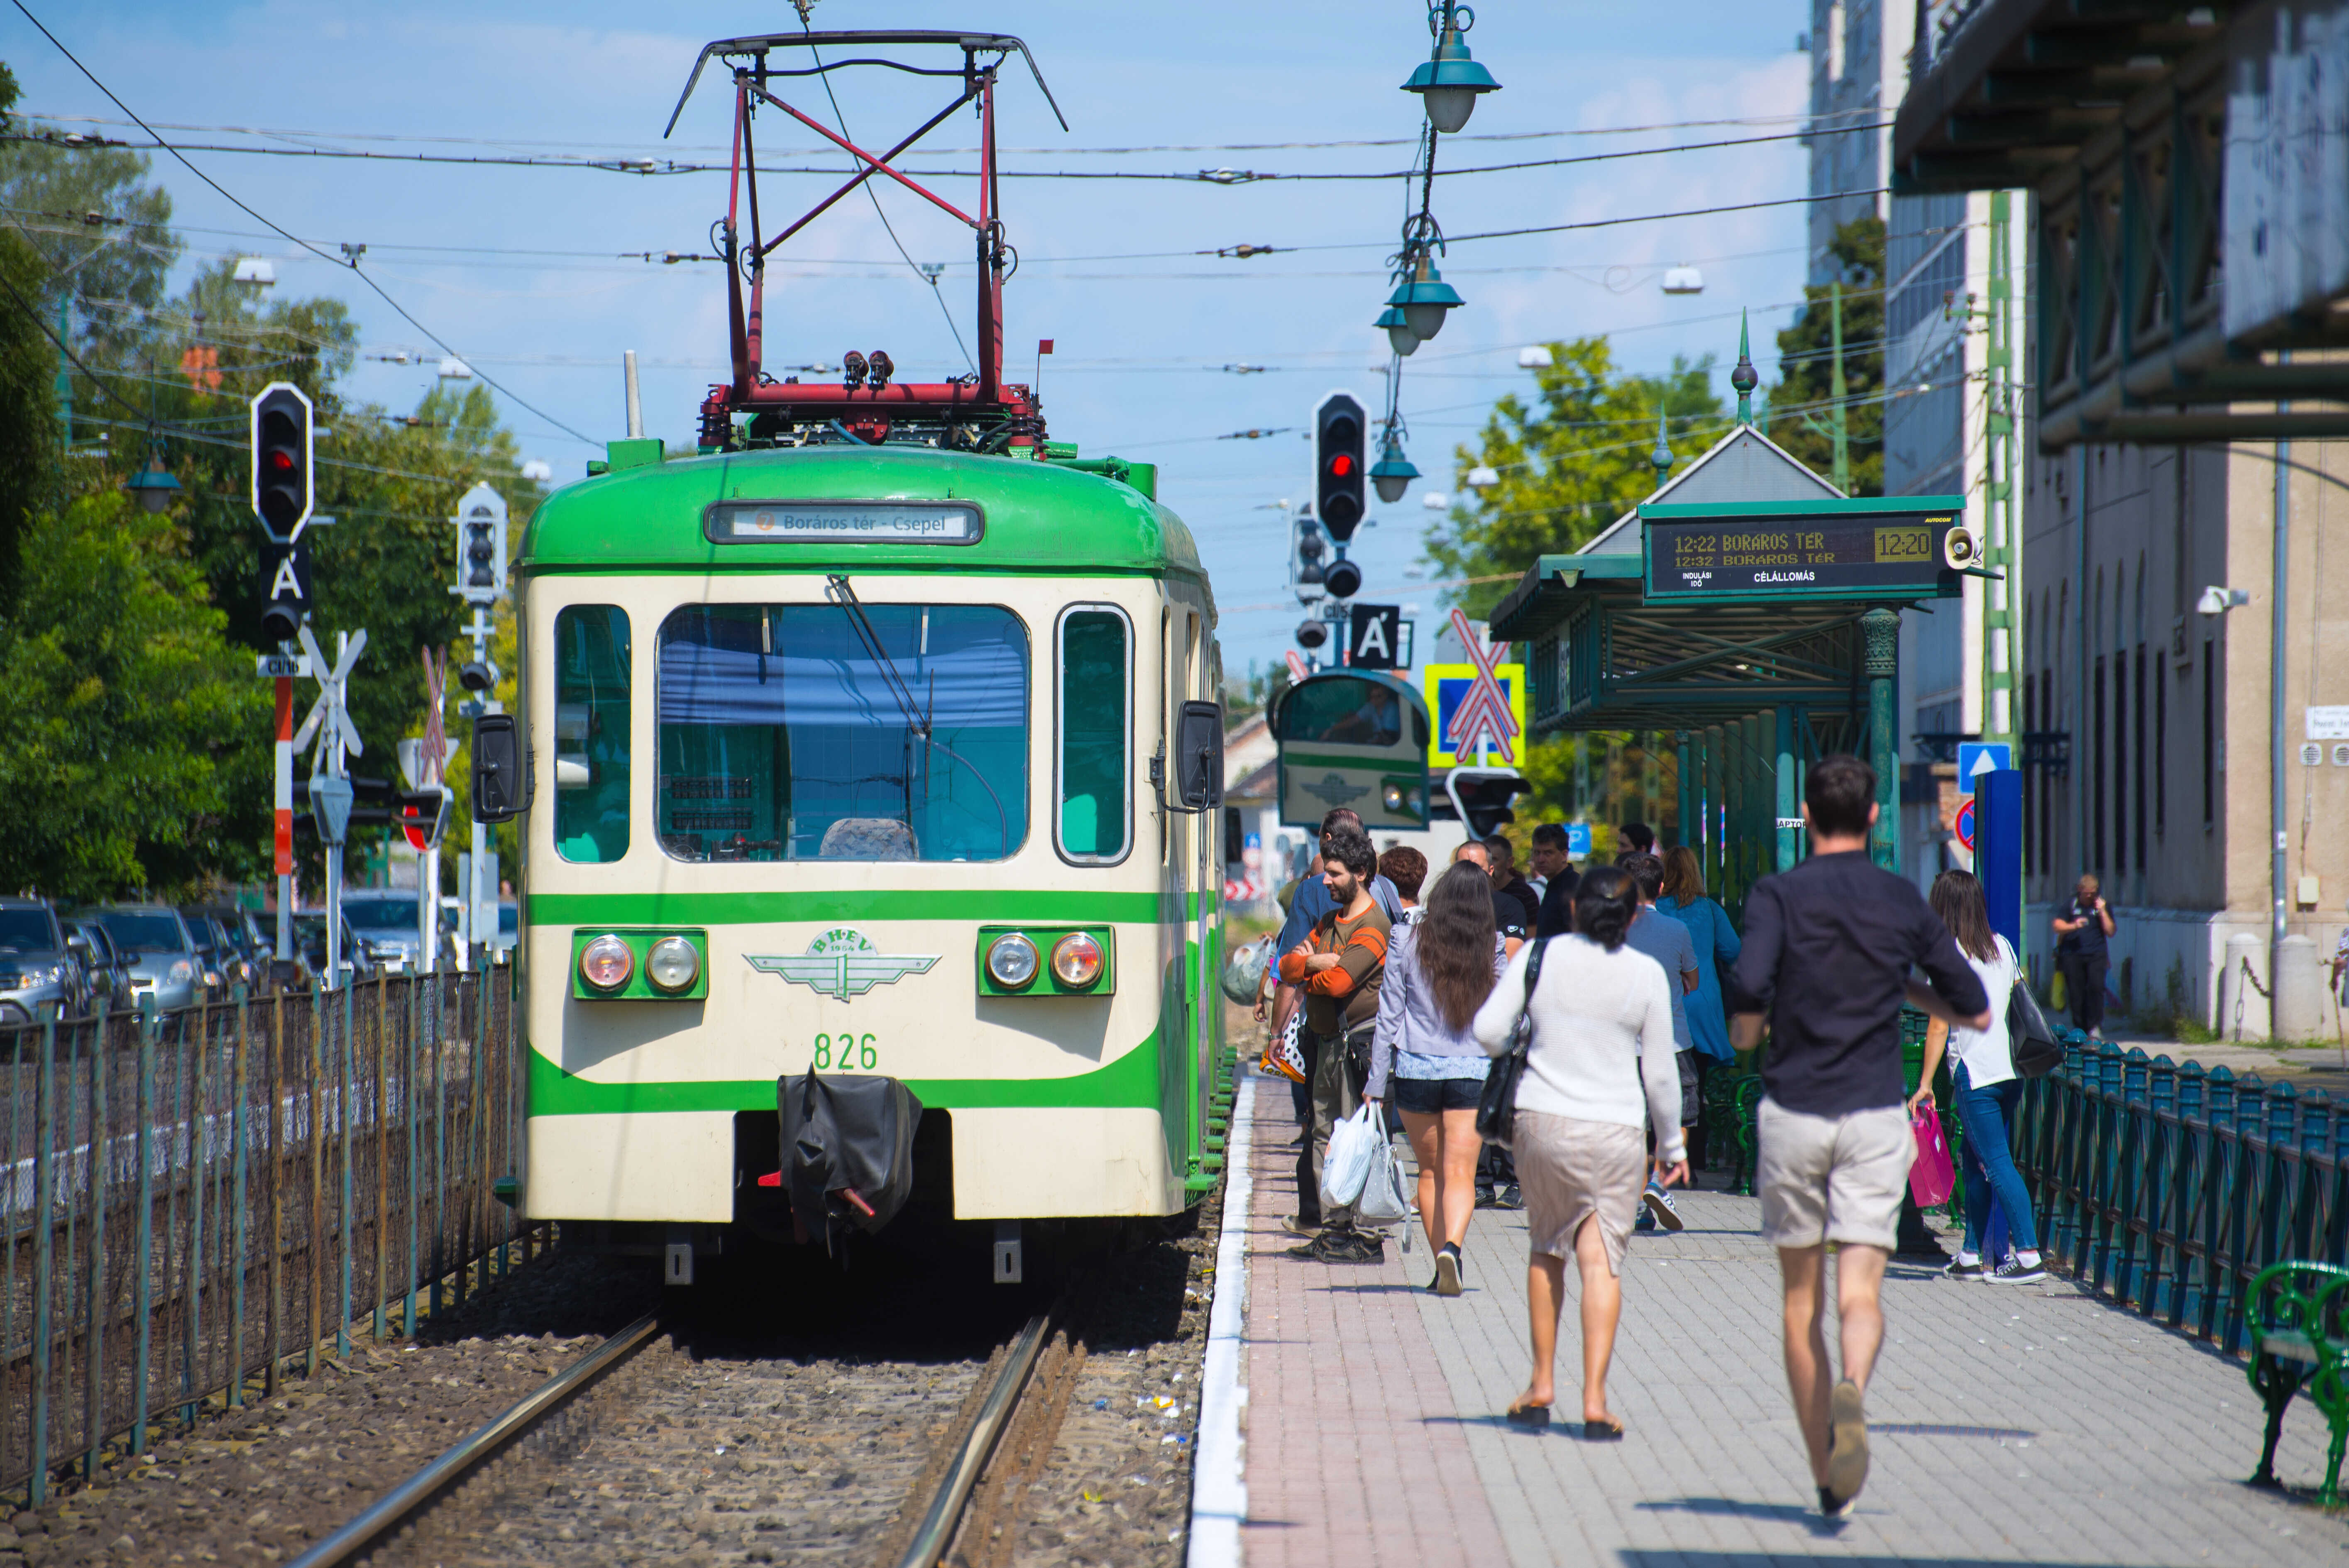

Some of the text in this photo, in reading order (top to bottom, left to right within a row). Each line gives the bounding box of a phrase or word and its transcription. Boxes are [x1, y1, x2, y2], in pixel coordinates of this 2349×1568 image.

[760, 515, 770, 528] 7
[784, 515, 848, 530] Boráros
[853, 515, 876, 530] tér
[893, 516, 945, 535] Csepel
[1675, 532, 1824, 552] 12:22 BORÁROS TÉR
[1879, 532, 1930, 556] 12:20
[1675, 552, 1835, 567] 12:32 BORÁROS TÉR
[1683, 570, 1712, 579] INDULÁSI
[1754, 569, 1816, 583] CÉLÁLLOMÁS
[811, 929, 872, 954] BHÉV
[814, 1033, 877, 1070] 826
